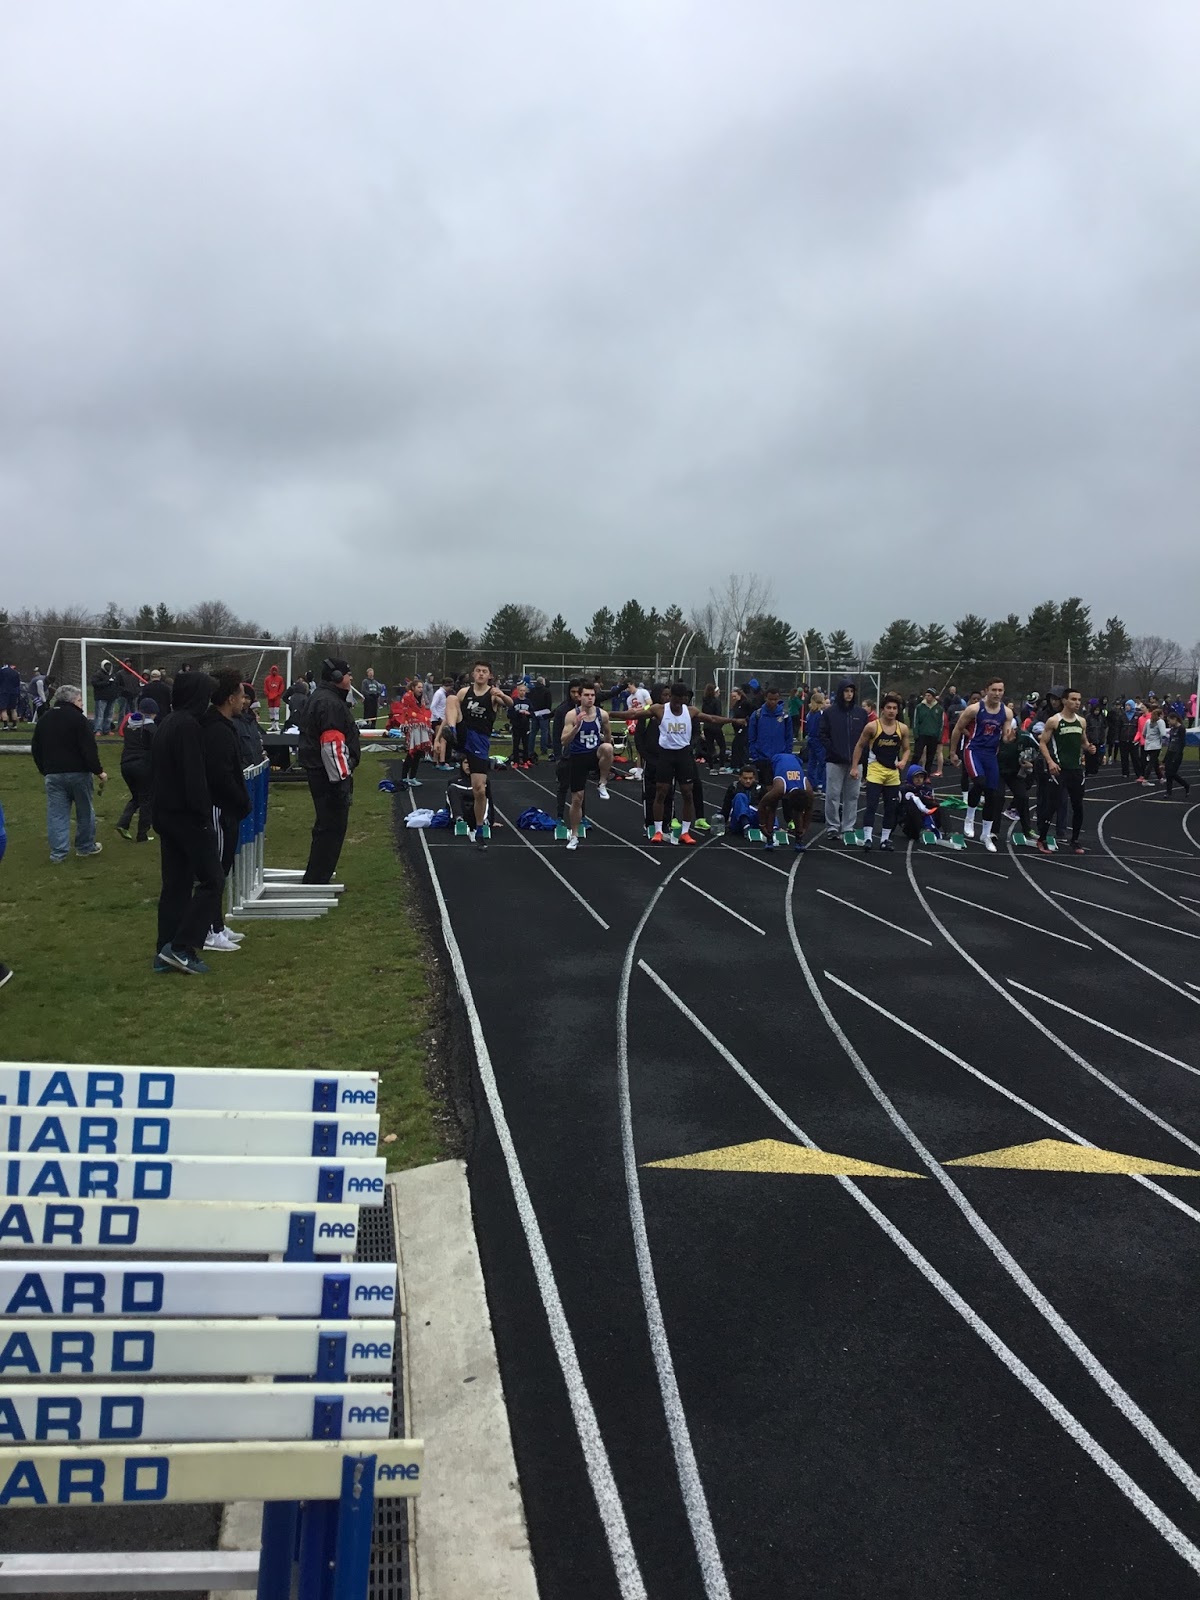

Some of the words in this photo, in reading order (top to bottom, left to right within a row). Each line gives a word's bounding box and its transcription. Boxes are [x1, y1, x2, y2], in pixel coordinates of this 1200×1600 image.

[5, 1272, 165, 1313] ARD
[0, 1331, 155, 1373] ARD
[0, 1457, 169, 1504] ARD
